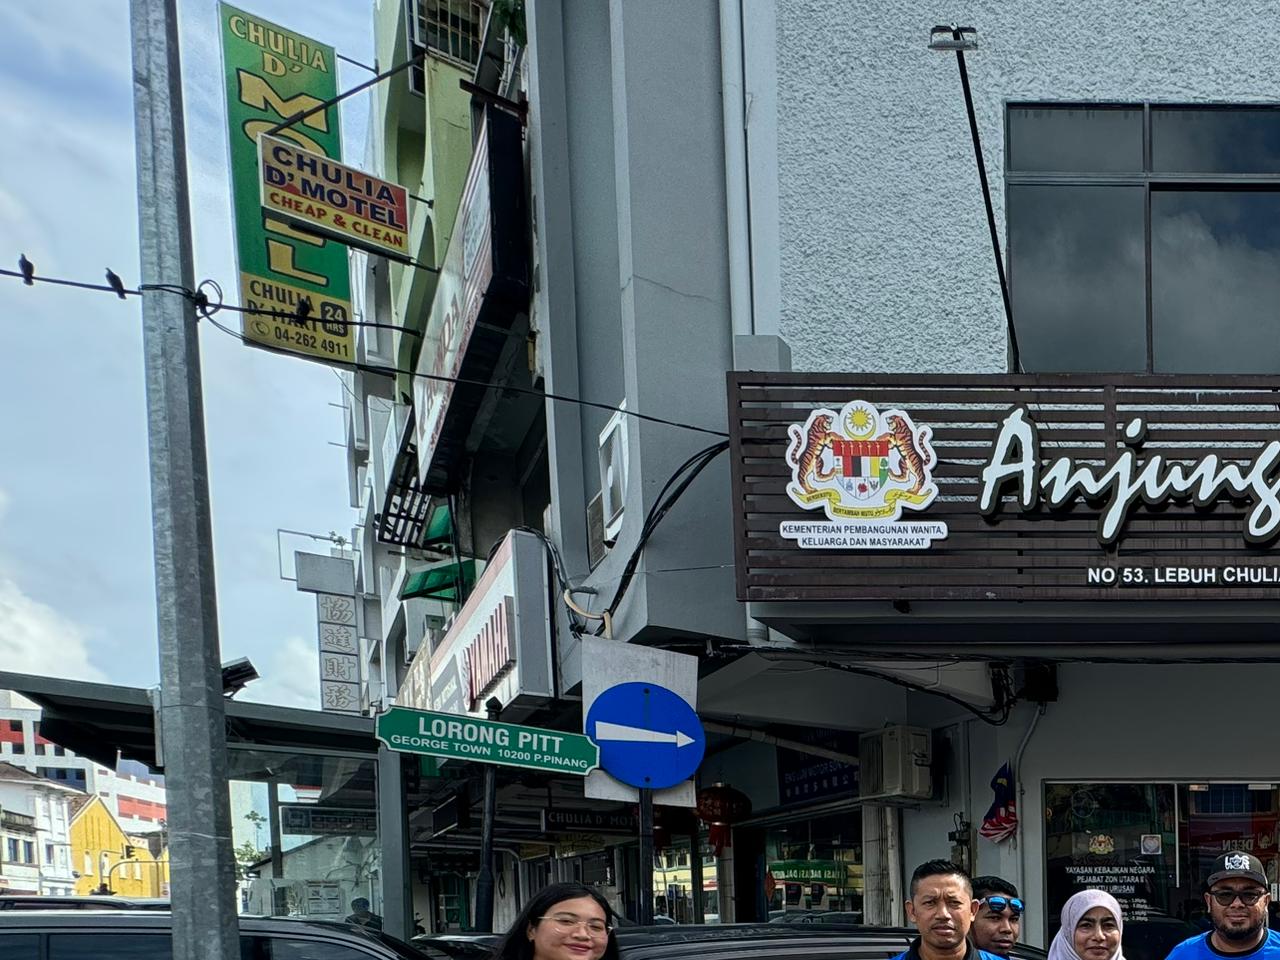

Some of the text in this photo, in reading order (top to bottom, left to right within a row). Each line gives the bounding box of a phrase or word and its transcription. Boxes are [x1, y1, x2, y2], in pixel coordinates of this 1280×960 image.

[229, 15, 328, 73] CHULIA
[272, 146, 396, 205] CHULIA
[301, 178, 403, 229] MOTEL
[269, 192, 403, 248] CHEAP & CLEAN
[249, 280, 315, 312] CHULIA
[324, 306, 343, 321] 24
[325, 321, 345, 335] HRS
[274, 326, 349, 357] 04-262 4911
[782, 525, 944, 535] KEMENTERIAN PEMBANGUNAN WANITA,
[801, 537, 925, 546] KELUARGA DAN MASYARAKAT
[1088, 568, 1115, 583] NO
[1122, 568, 1149, 583] 53.
[1155, 568, 1216, 583] LEBUH
[418, 716, 564, 753] LORONG PITT
[390, 734, 588, 769] GEORGE TOWN 10200 P.PINANG
[548, 811, 593, 824] CHULIA
[1065, 866, 1156, 874] YAYASAN KEBAJIKAN NEGARA
[1109, 885, 1135, 893] URUSAN
